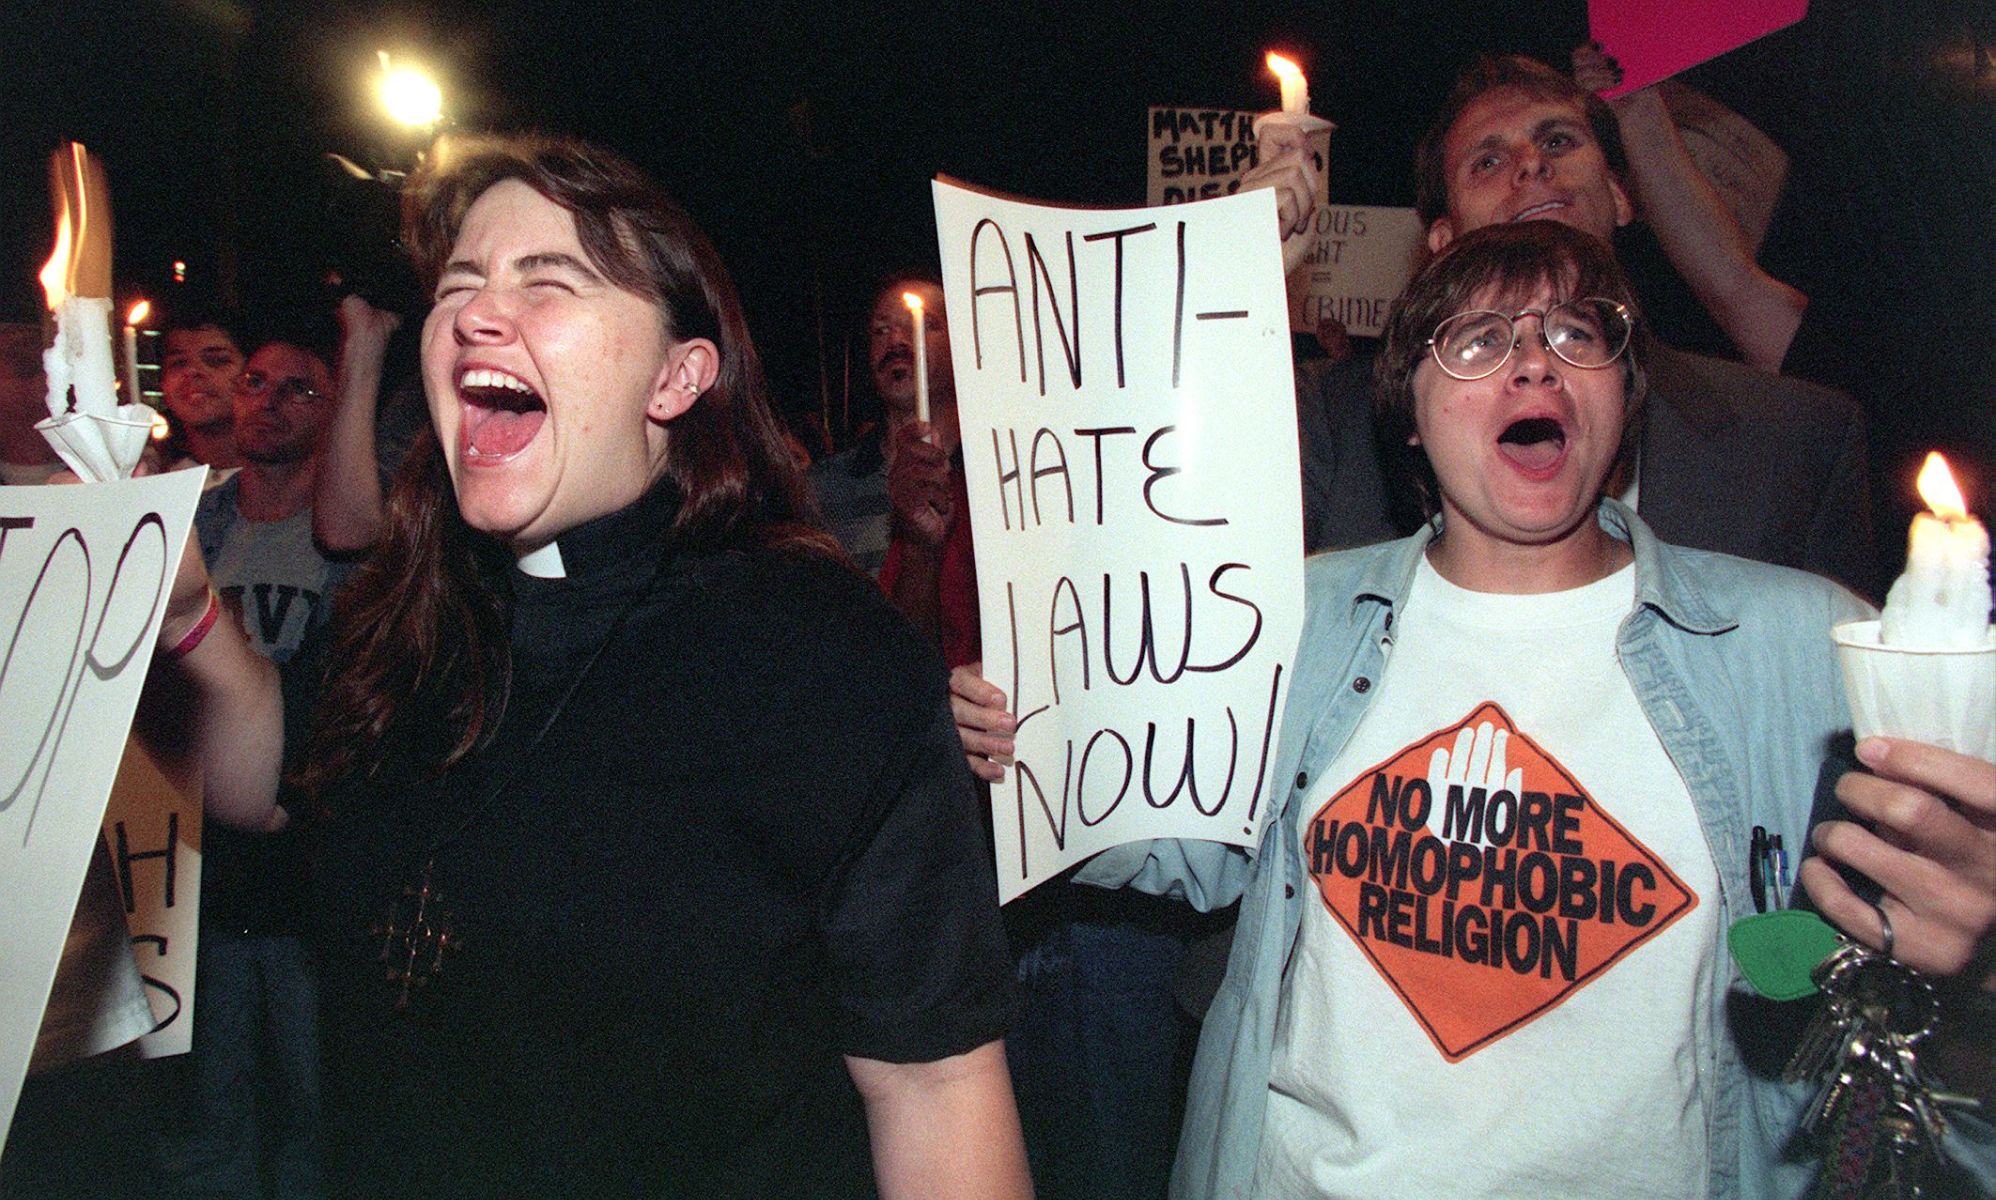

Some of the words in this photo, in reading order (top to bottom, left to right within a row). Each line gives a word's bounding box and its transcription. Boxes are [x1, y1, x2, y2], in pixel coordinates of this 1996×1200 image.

[1153, 109, 1256, 143] MATTH
[1315, 208, 1367, 237] OUS
[970, 217, 1249, 396] ANTI-
[991, 424, 1229, 532] HATE
[1006, 561, 1263, 734] LAWS
[1014, 663, 1283, 879] NOW!
[1365, 772, 1433, 833] NO
[1441, 783, 1587, 856] MORE
[1311, 817, 1658, 928] HOMOPHOBIC
[1357, 881, 1579, 982] RELIGION
